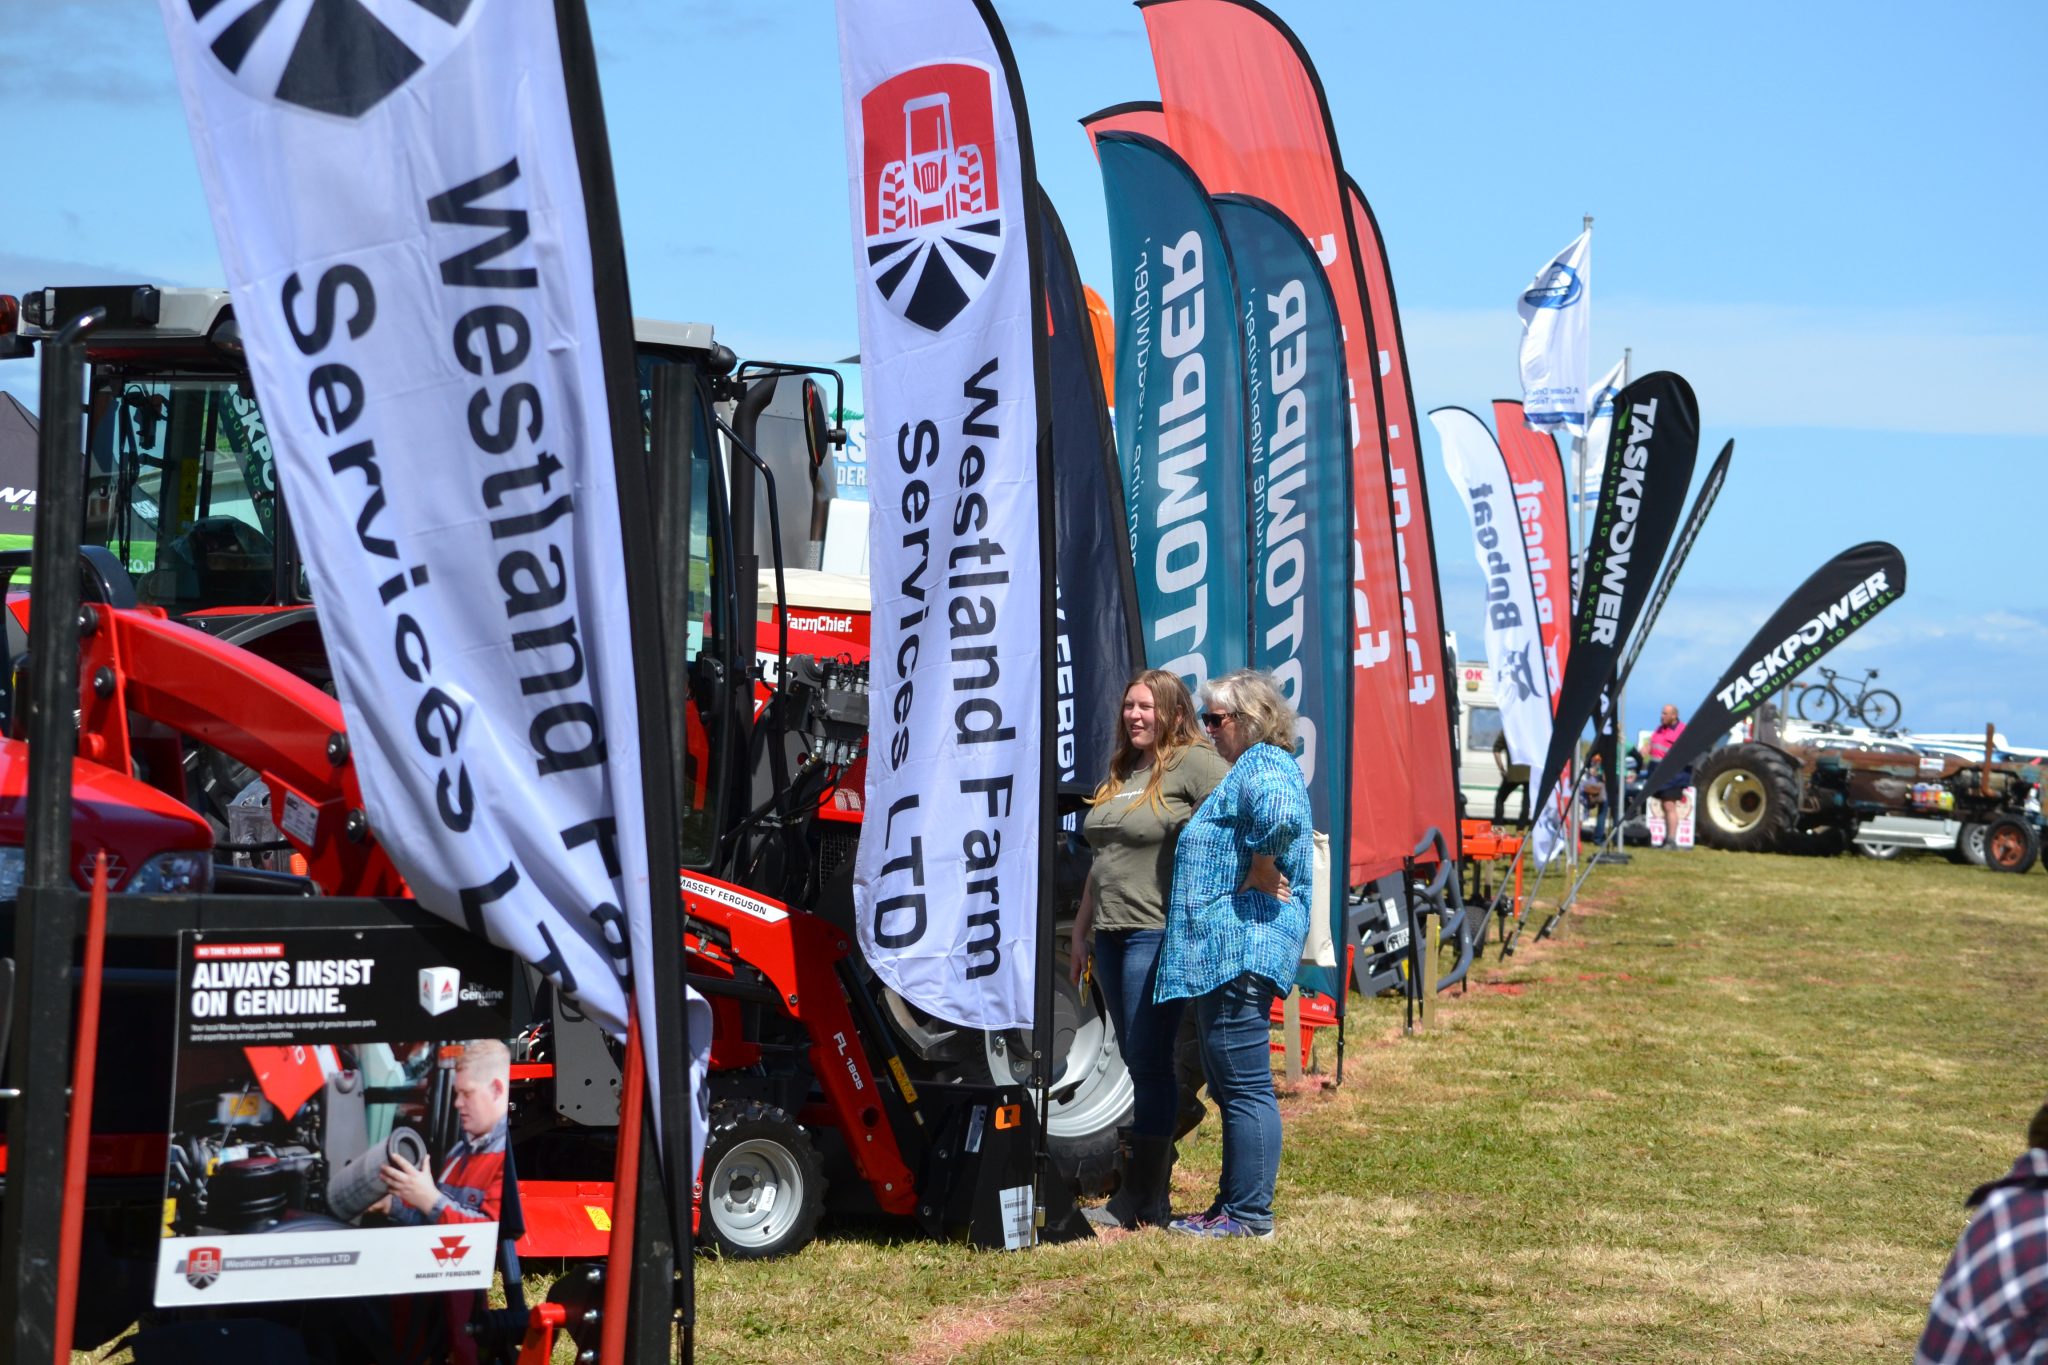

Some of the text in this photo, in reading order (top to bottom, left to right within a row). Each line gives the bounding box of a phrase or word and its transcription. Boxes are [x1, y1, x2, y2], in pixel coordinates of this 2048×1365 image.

[1590, 398, 1658, 646] TASKPOWER
[1599, 438, 1622, 538] EQUIPPED
[281, 263, 475, 833] Services
[427, 156, 632, 994] Westland Fa
[1593, 548, 1605, 573] TO
[1578, 583, 1598, 644] EXCEL
[1716, 570, 1890, 711] TASKPOWER
[1753, 591, 1895, 701] EQUIPPED TO EXCEL
[873, 419, 940, 950] Services LTD
[947, 356, 1017, 980] Westland Farm
[680, 879, 768, 916] MASSEY FERGUSON
[191, 958, 375, 989] ALWAYS INSIST
[191, 987, 347, 1017] ON GENUINE.
[833, 1031, 864, 1090] FL 1805
[225, 1254, 351, 1269] Westland Farm Services LTD
[444, 1270, 481, 1278] FERGUSON
